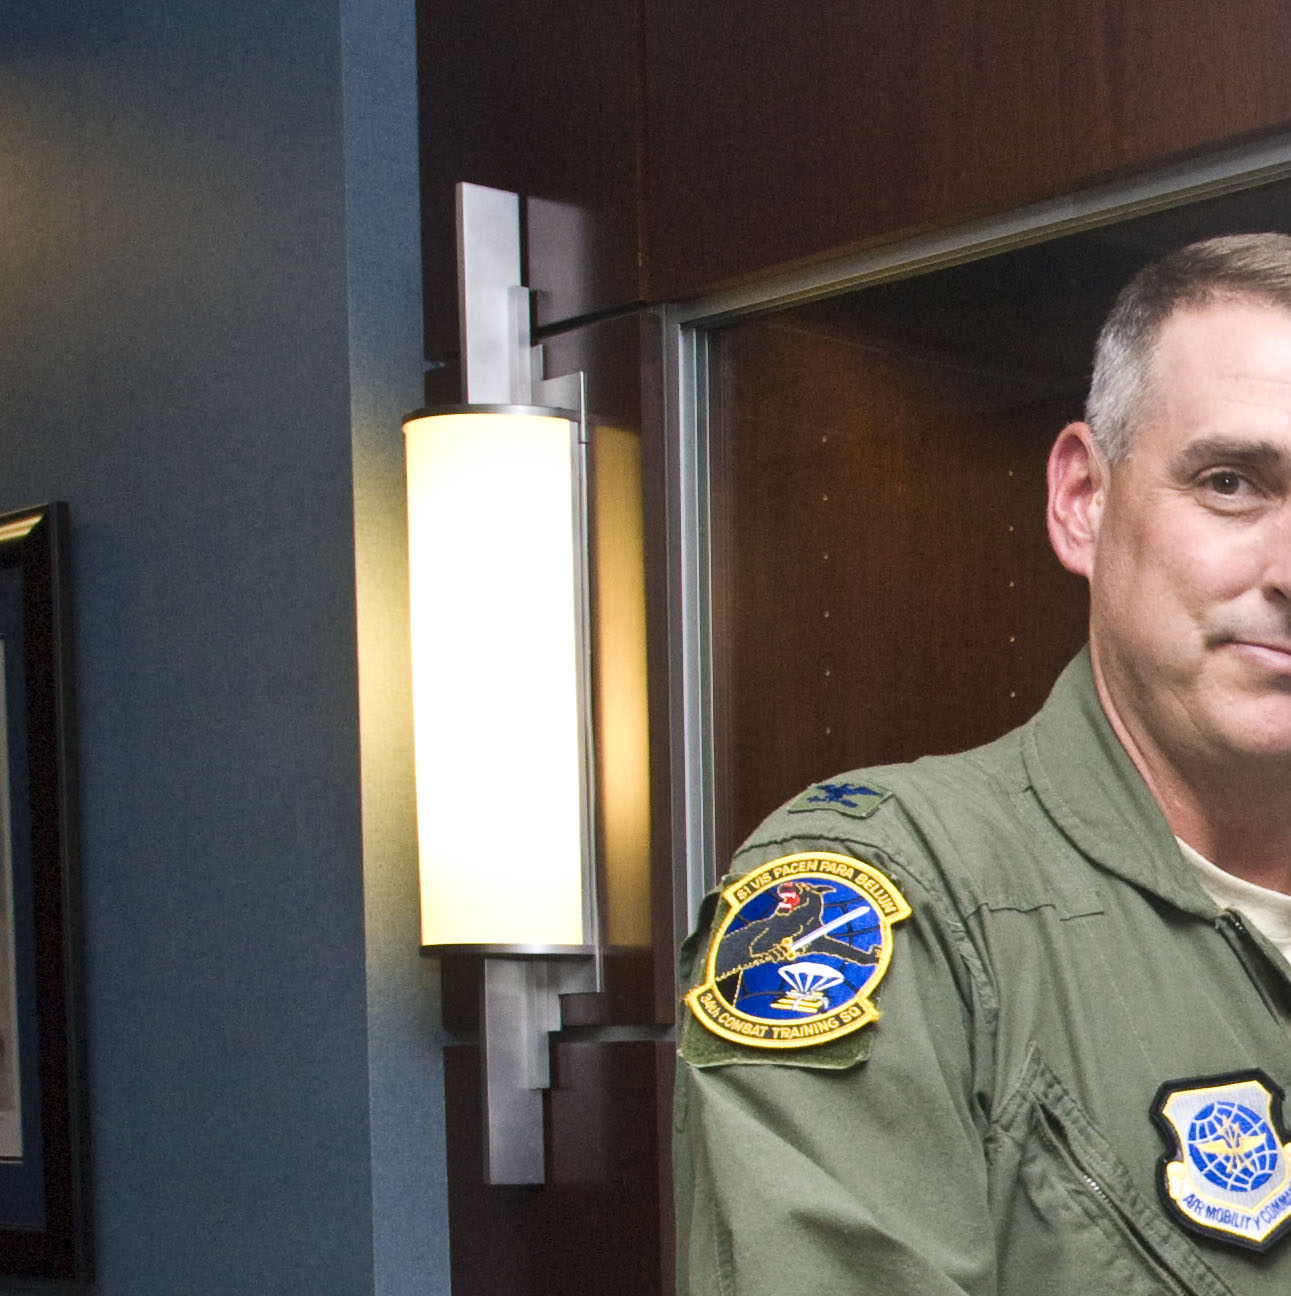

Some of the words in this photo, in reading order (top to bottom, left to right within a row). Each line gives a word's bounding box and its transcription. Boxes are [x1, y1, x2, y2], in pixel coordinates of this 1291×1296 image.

[736, 887, 751, 901] SI
[751, 873, 773, 893] VIS
[773, 861, 818, 879] PACEM
[819, 861, 854, 879] PARA
[855, 872, 898, 914] BELLUM
[718, 1013, 768, 1038] COMBAT
[772, 1017, 839, 1039] TRAINING
[841, 1005, 864, 1024] SQ
[1182, 1193, 1205, 1215] AIR
[1206, 1205, 1262, 1231] MOBILITY
